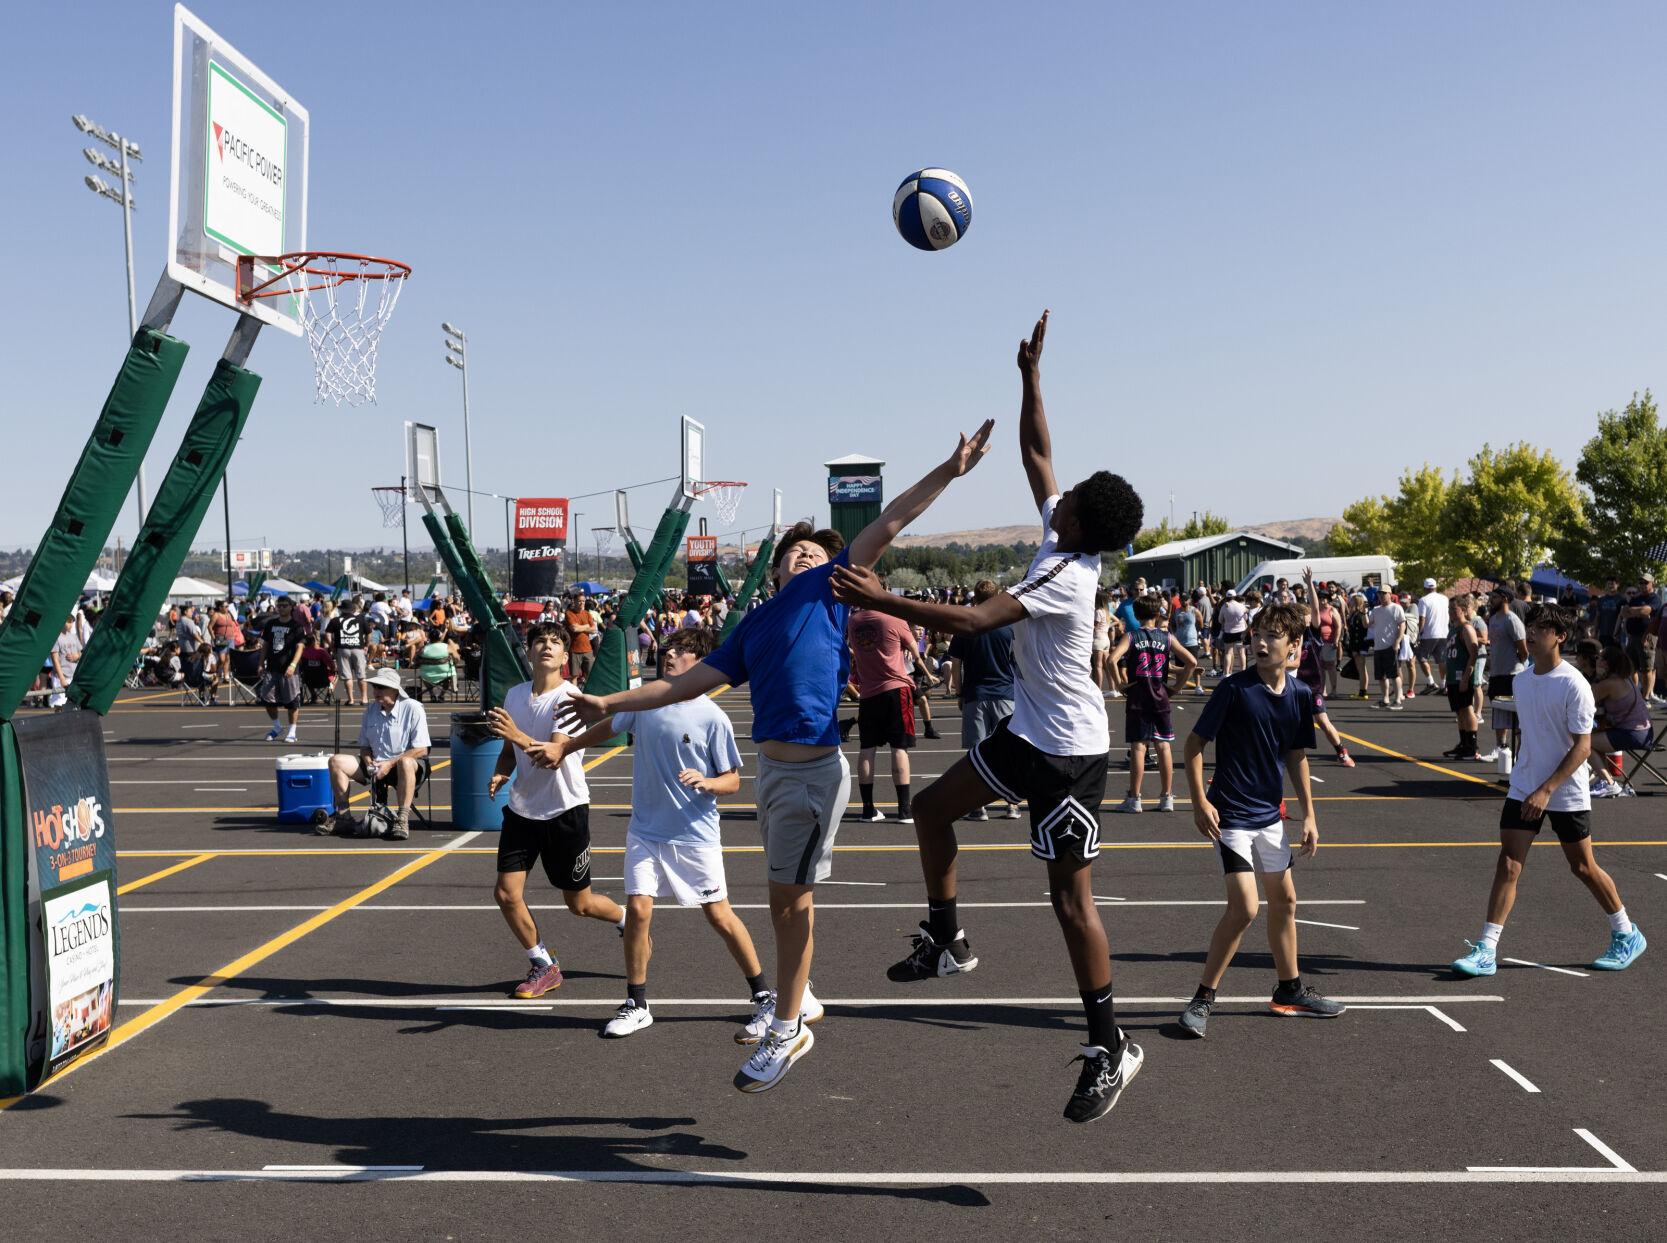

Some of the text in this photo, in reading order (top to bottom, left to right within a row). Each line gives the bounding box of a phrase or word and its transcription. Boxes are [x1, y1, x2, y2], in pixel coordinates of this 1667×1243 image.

[224, 130, 282, 189] PACIFIC POWER
[519, 507, 564, 516] HIGH SCHOOL
[519, 516, 563, 528] DIVISION
[689, 540, 715, 550] YOUTH
[1134, 640, 1166, 651] MENOZA
[1135, 651, 1166, 678] 22
[71, 843, 97, 863] TOURNEY
[52, 906, 109, 957] LEGENDS
